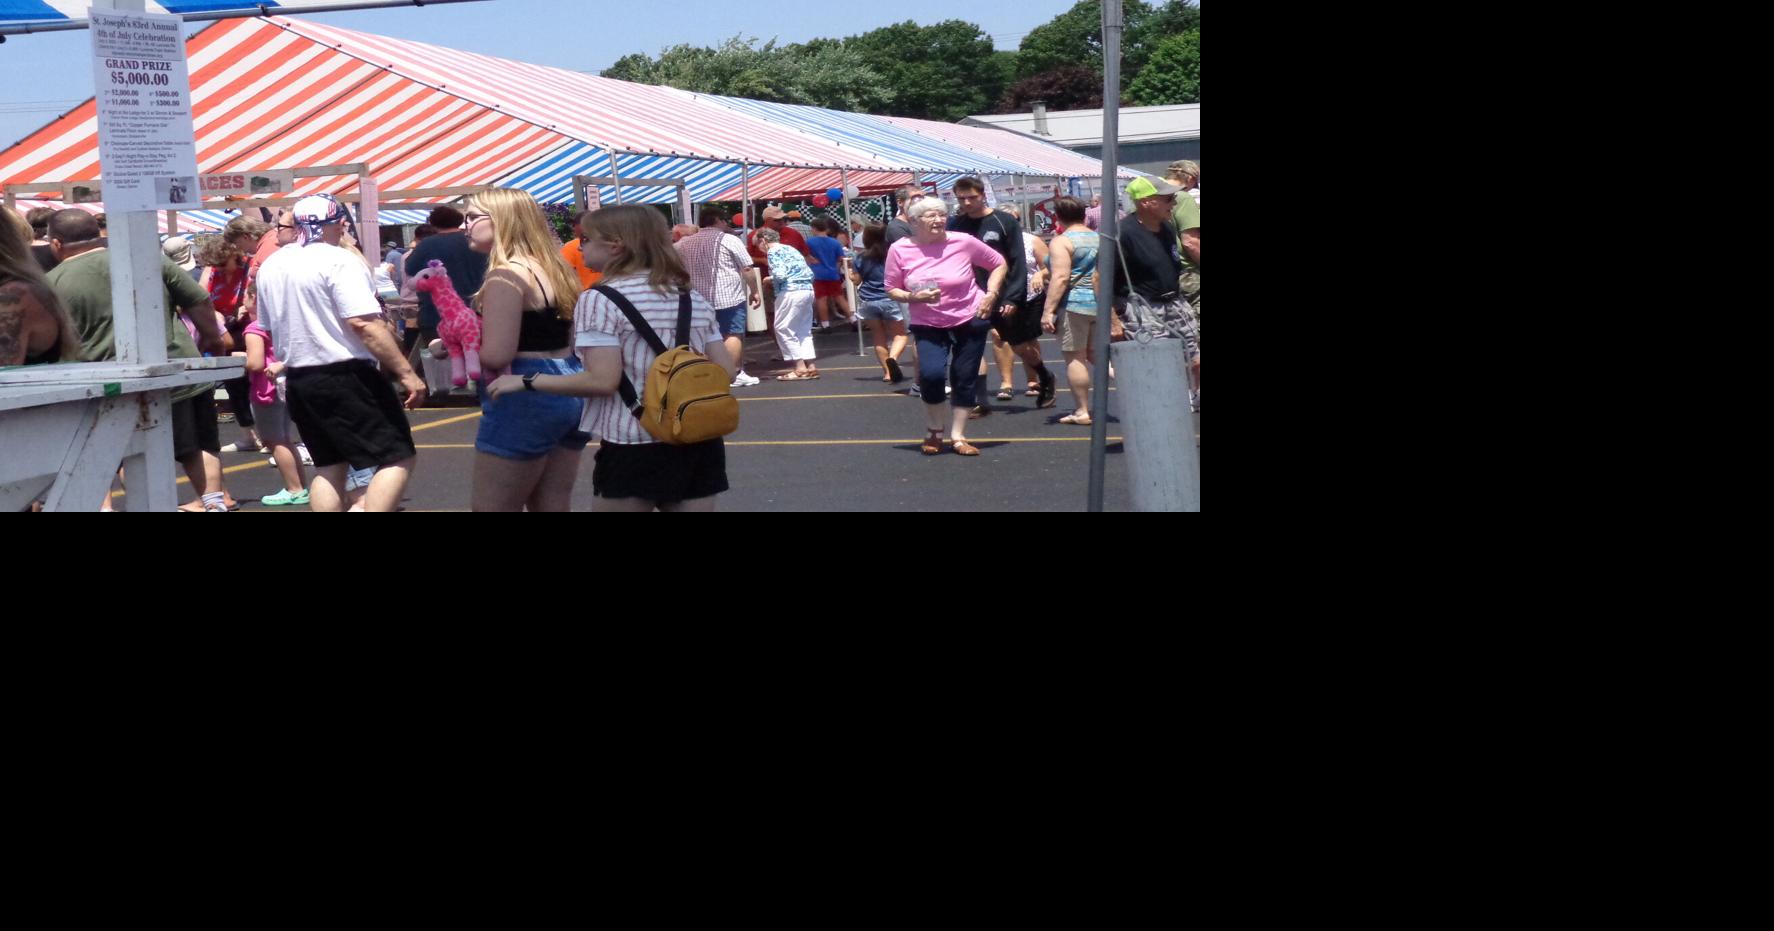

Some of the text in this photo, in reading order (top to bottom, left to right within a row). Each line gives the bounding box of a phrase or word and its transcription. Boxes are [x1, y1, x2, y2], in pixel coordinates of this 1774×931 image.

[102, 18, 131, 29] Joseph's
[151, 22, 178, 31] Annual
[108, 30, 116, 38] of
[117, 32, 131, 41] July
[133, 32, 176, 43] Celebration
[105, 59, 172, 71] GRAND PRIZE
[111, 70, 169, 88] $5,000.00
[111, 89, 139, 98] $2,000.00
[155, 90, 179, 98] $500.00
